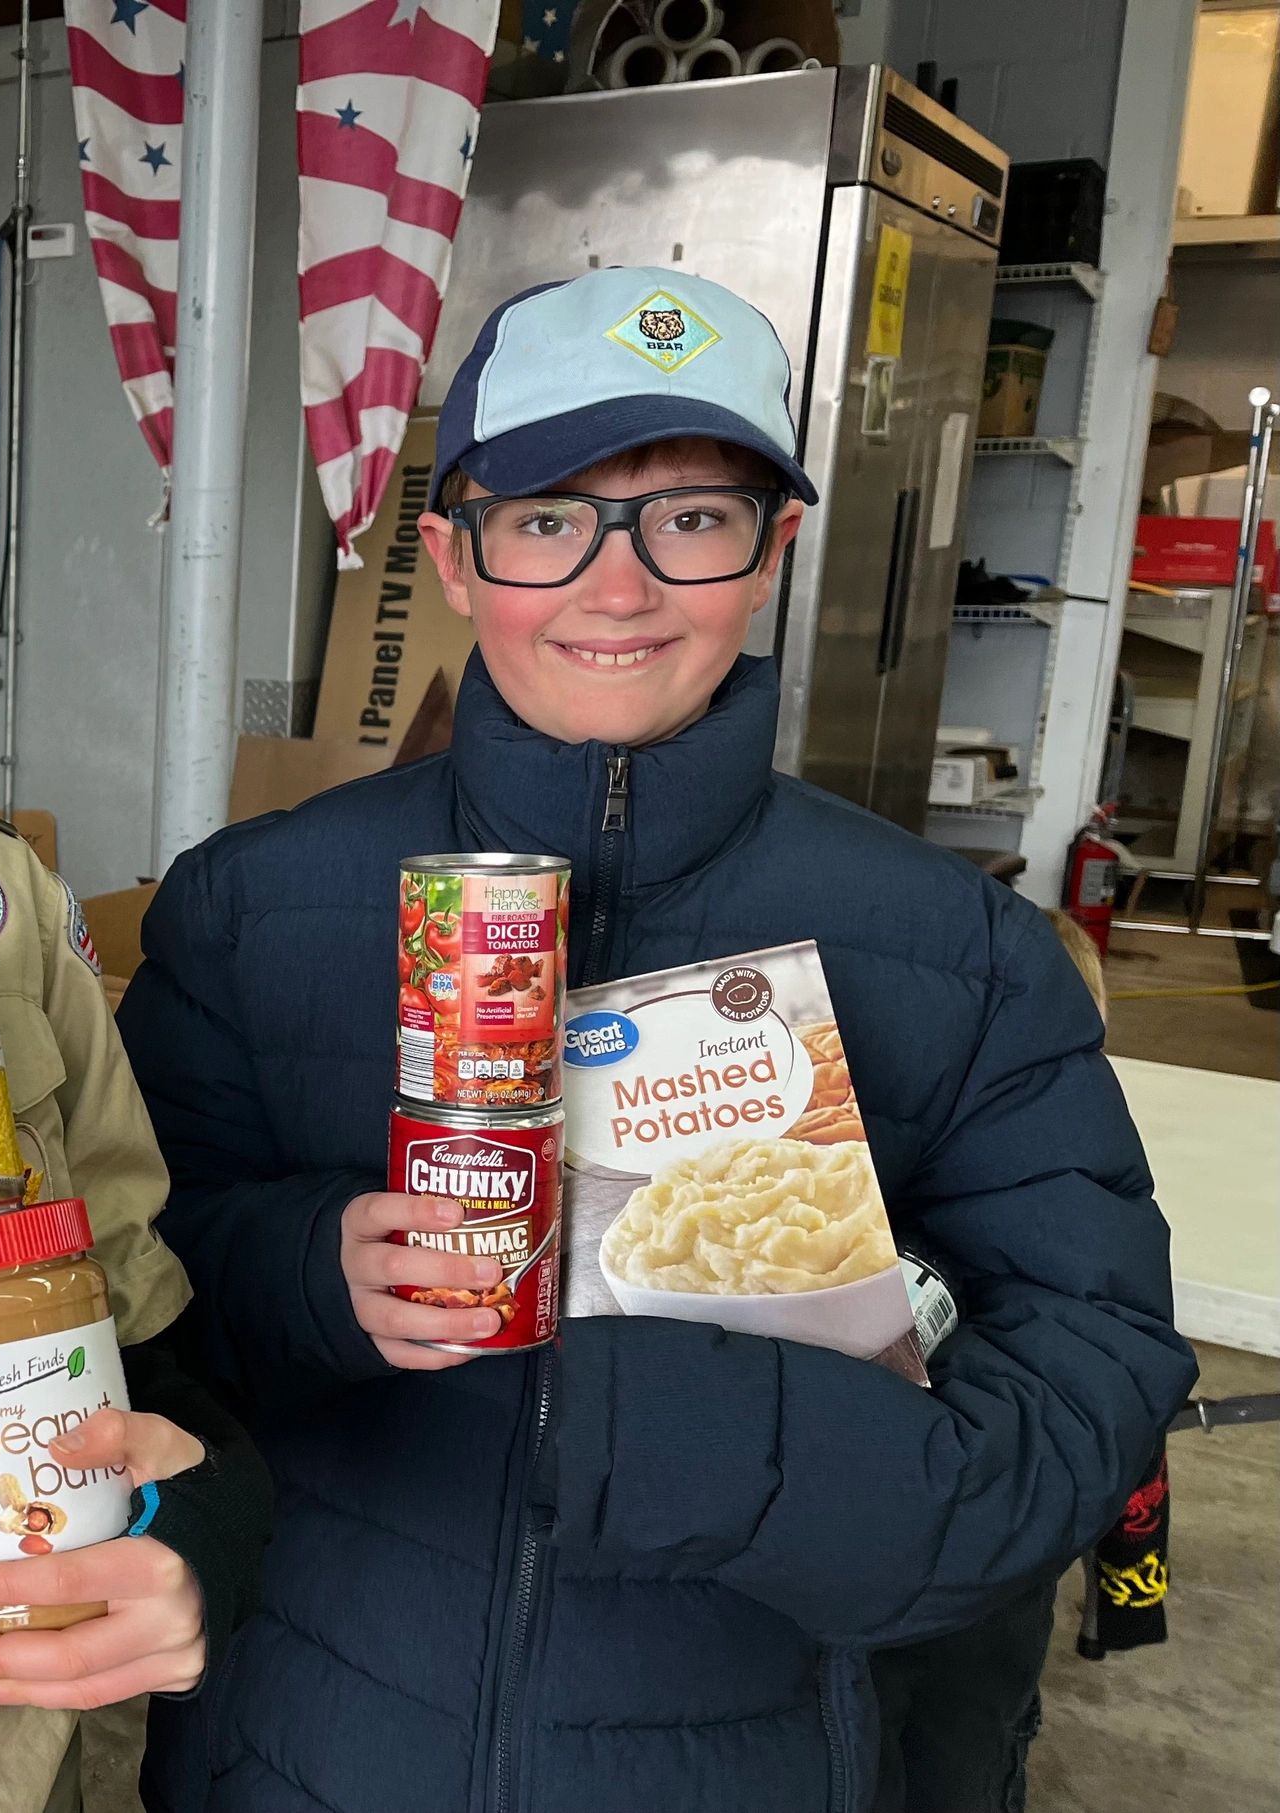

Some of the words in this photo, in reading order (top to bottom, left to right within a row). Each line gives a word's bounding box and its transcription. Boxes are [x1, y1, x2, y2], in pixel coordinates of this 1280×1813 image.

[646, 342, 684, 351] BEAR
[385, 463, 433, 574] Mount
[376, 581, 413, 624] TV
[359, 631, 405, 728] Panel
[484, 886, 528, 901] Happy
[490, 898, 540, 911] Harvest
[491, 914, 506, 922] FIRE
[507, 913, 538, 921] ROASTED
[486, 923, 540, 940] DICED
[487, 939, 539, 950] TOMATOES
[432, 973, 453, 982] NON
[432, 980, 454, 991] BPA
[715, 971, 735, 992] MADE
[736, 970, 757, 980] WITH
[486, 1006, 512, 1014] Artificial
[720, 1005, 740, 1020] REAL
[741, 990, 770, 1020] POTATOES
[564, 1021, 624, 1049] Great
[578, 1039, 626, 1058] Value
[698, 1030, 769, 1059] Instant
[461, 1061, 471, 1070] 25
[611, 1050, 778, 1110] Mashed
[457, 1089, 469, 1098] NET
[471, 1089, 482, 1098] WT
[609, 1093, 786, 1149] Potatoes
[411, 1158, 529, 1202] CHUNKY
[471, 1199, 487, 1209] LIKE
[487, 1199, 494, 1209] A
[493, 1199, 511, 1209] MEAL
[407, 1230, 469, 1256] CHILI
[472, 1226, 528, 1256] MAC
[501, 1254, 509, 1264] &
[509, 1249, 529, 1262] MEAT
[28, 1347, 65, 1377] Finds
